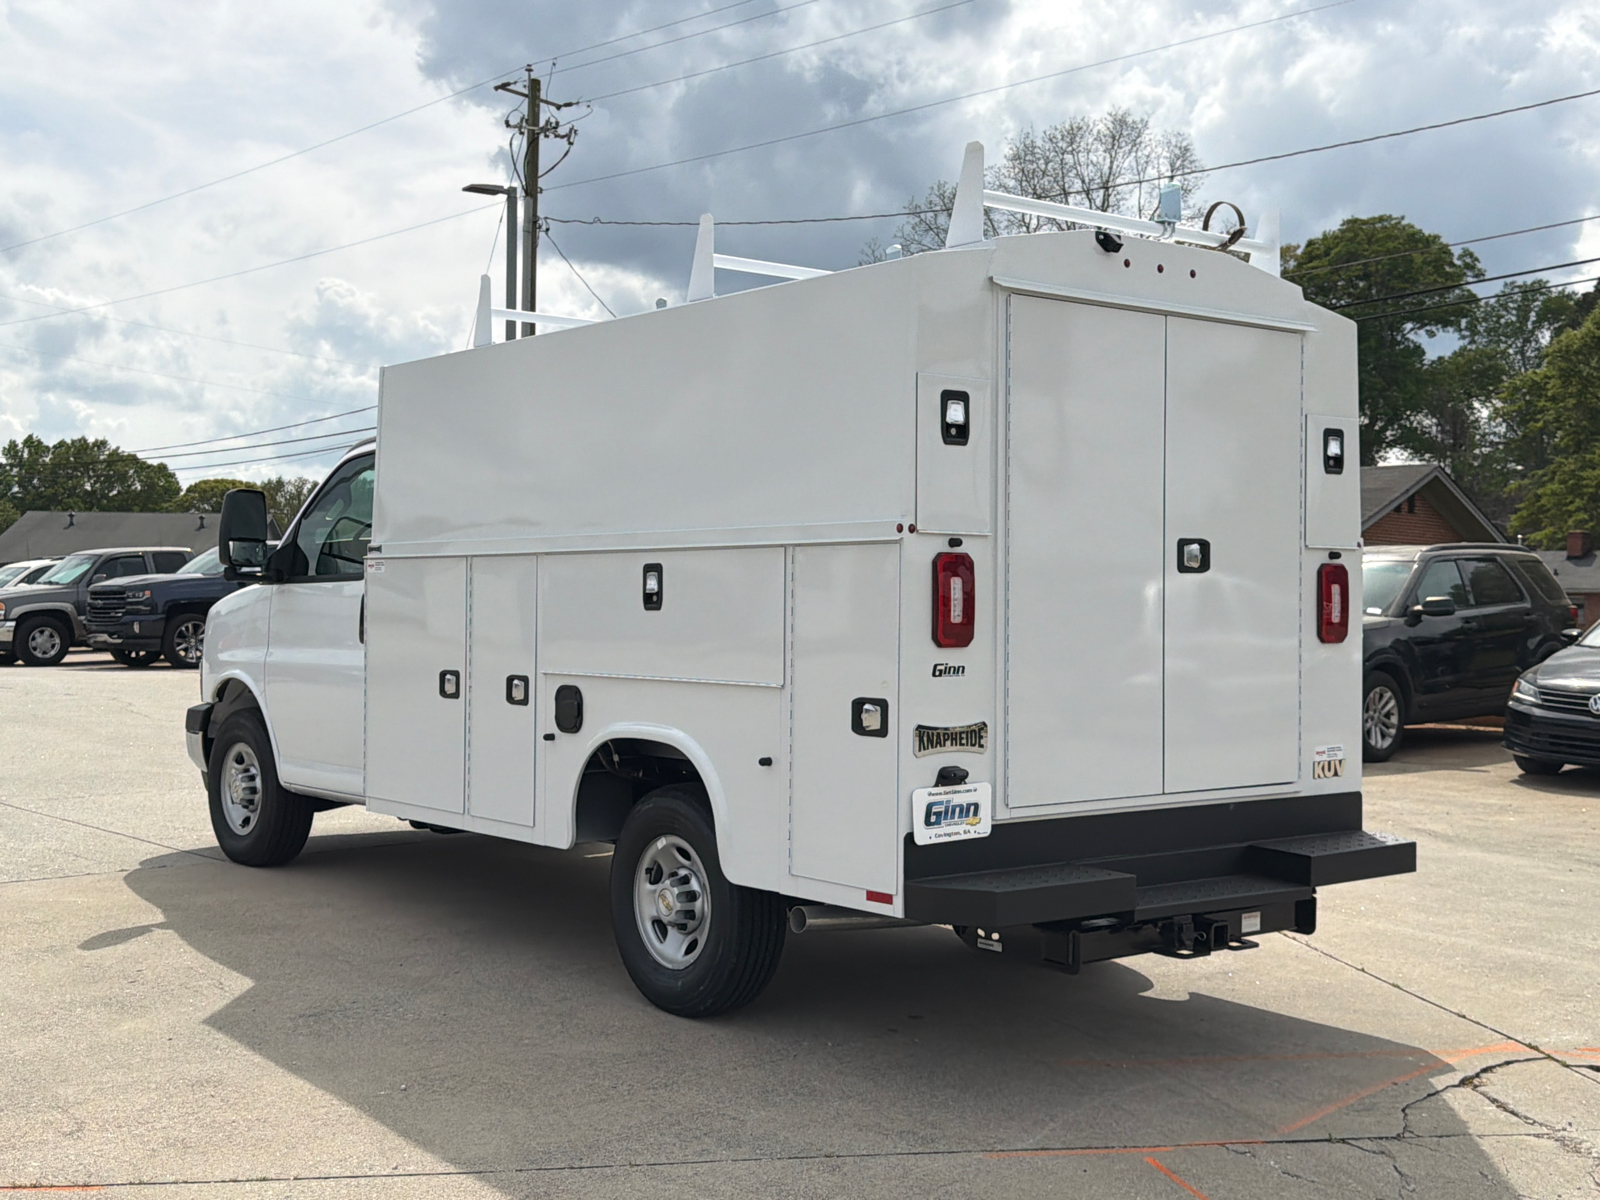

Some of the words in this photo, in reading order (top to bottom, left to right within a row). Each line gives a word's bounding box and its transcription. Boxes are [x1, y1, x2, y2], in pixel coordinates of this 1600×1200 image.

[932, 663, 965, 677] Ginn
[918, 727, 984, 752] KNAPHEIDE
[1313, 759, 1346, 779] KUV
[924, 800, 979, 827] Ginn
